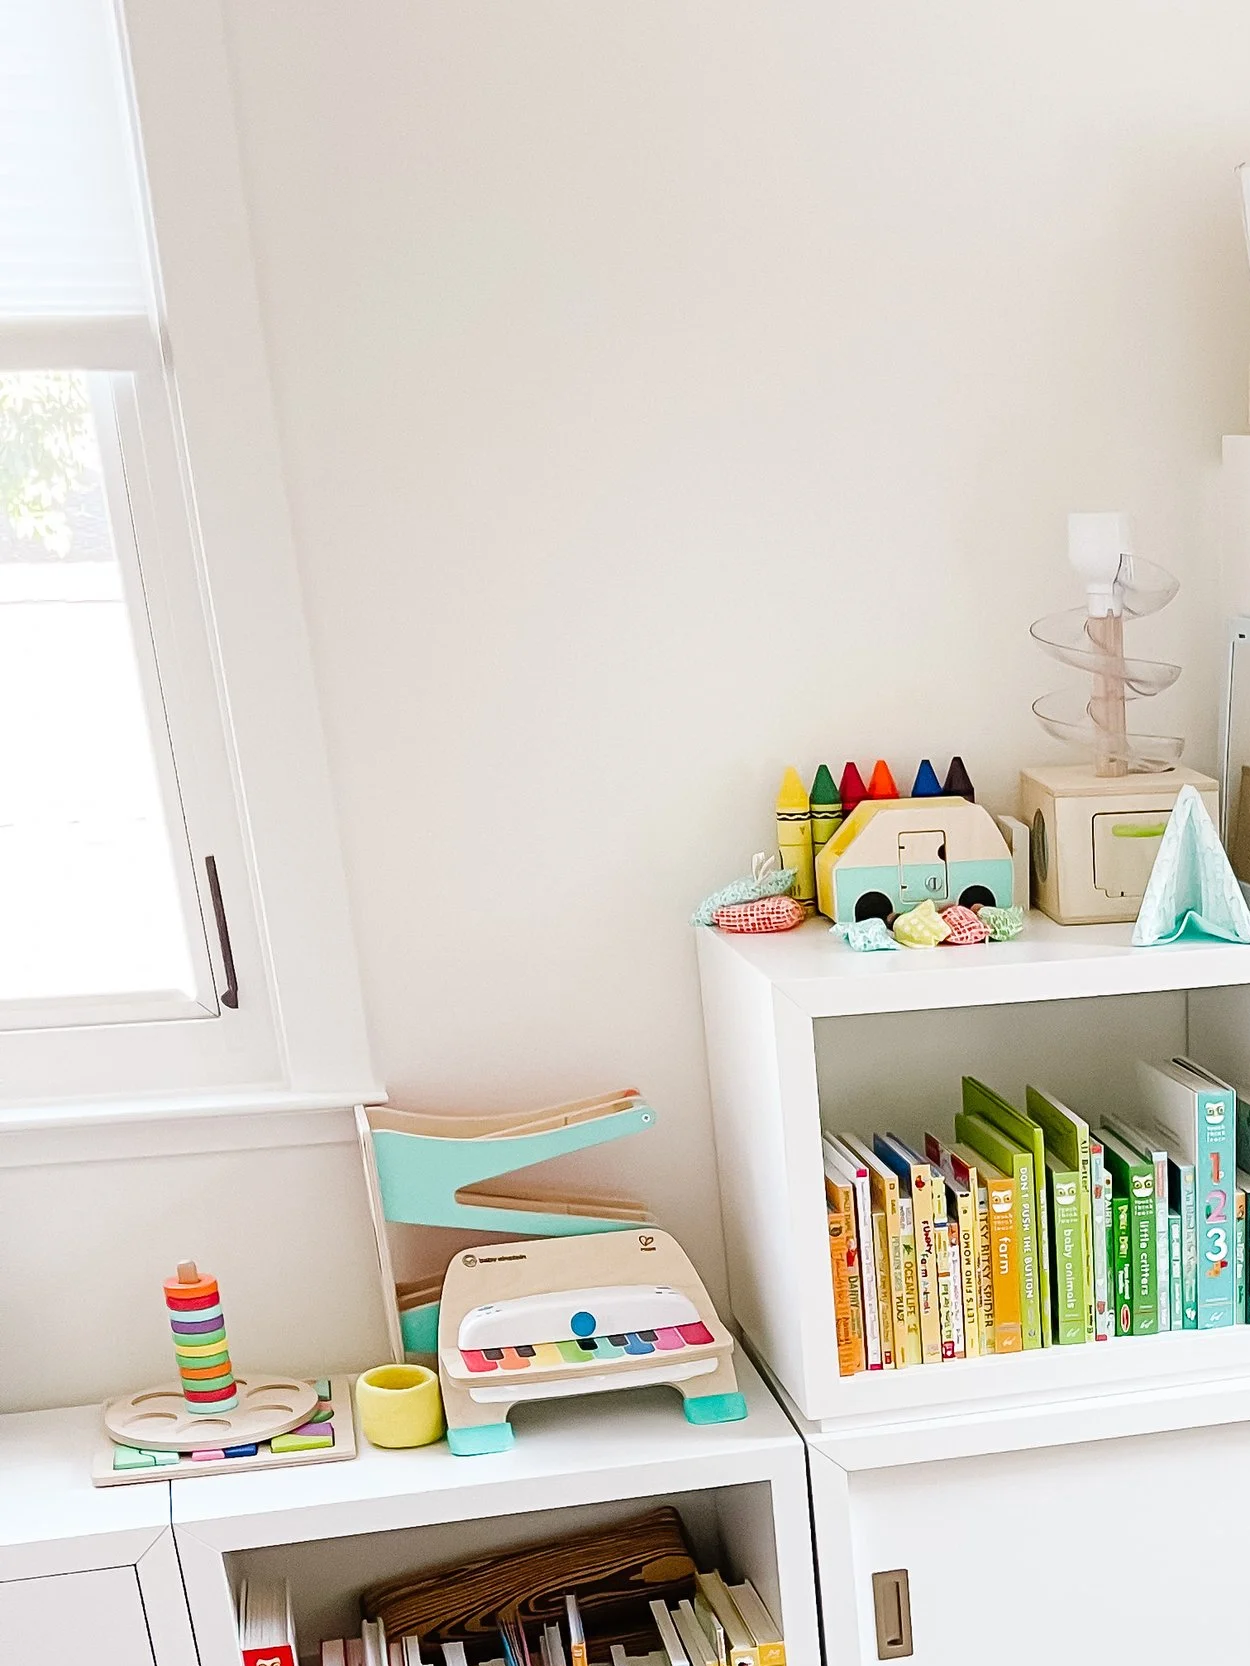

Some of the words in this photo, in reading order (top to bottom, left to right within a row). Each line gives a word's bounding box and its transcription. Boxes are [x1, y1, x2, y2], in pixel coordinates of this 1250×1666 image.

[979, 1211, 989, 1240] ITSY
[1021, 1203, 1031, 1231] PUSH
[1023, 1235, 1032, 1253] THE
[1062, 1229, 1075, 1259] baby
[1139, 1219, 1151, 1249] little
[980, 1245, 992, 1280] BITSY
[998, 1237, 1011, 1275] farm
[903, 1260, 914, 1296] OCEAN
[965, 1270, 974, 1294] FIND
[1063, 1262, 1077, 1309] animals
[1139, 1252, 1151, 1296] critters
[905, 1297, 916, 1317] LIFE
[983, 1284, 994, 1328] SPIDER
